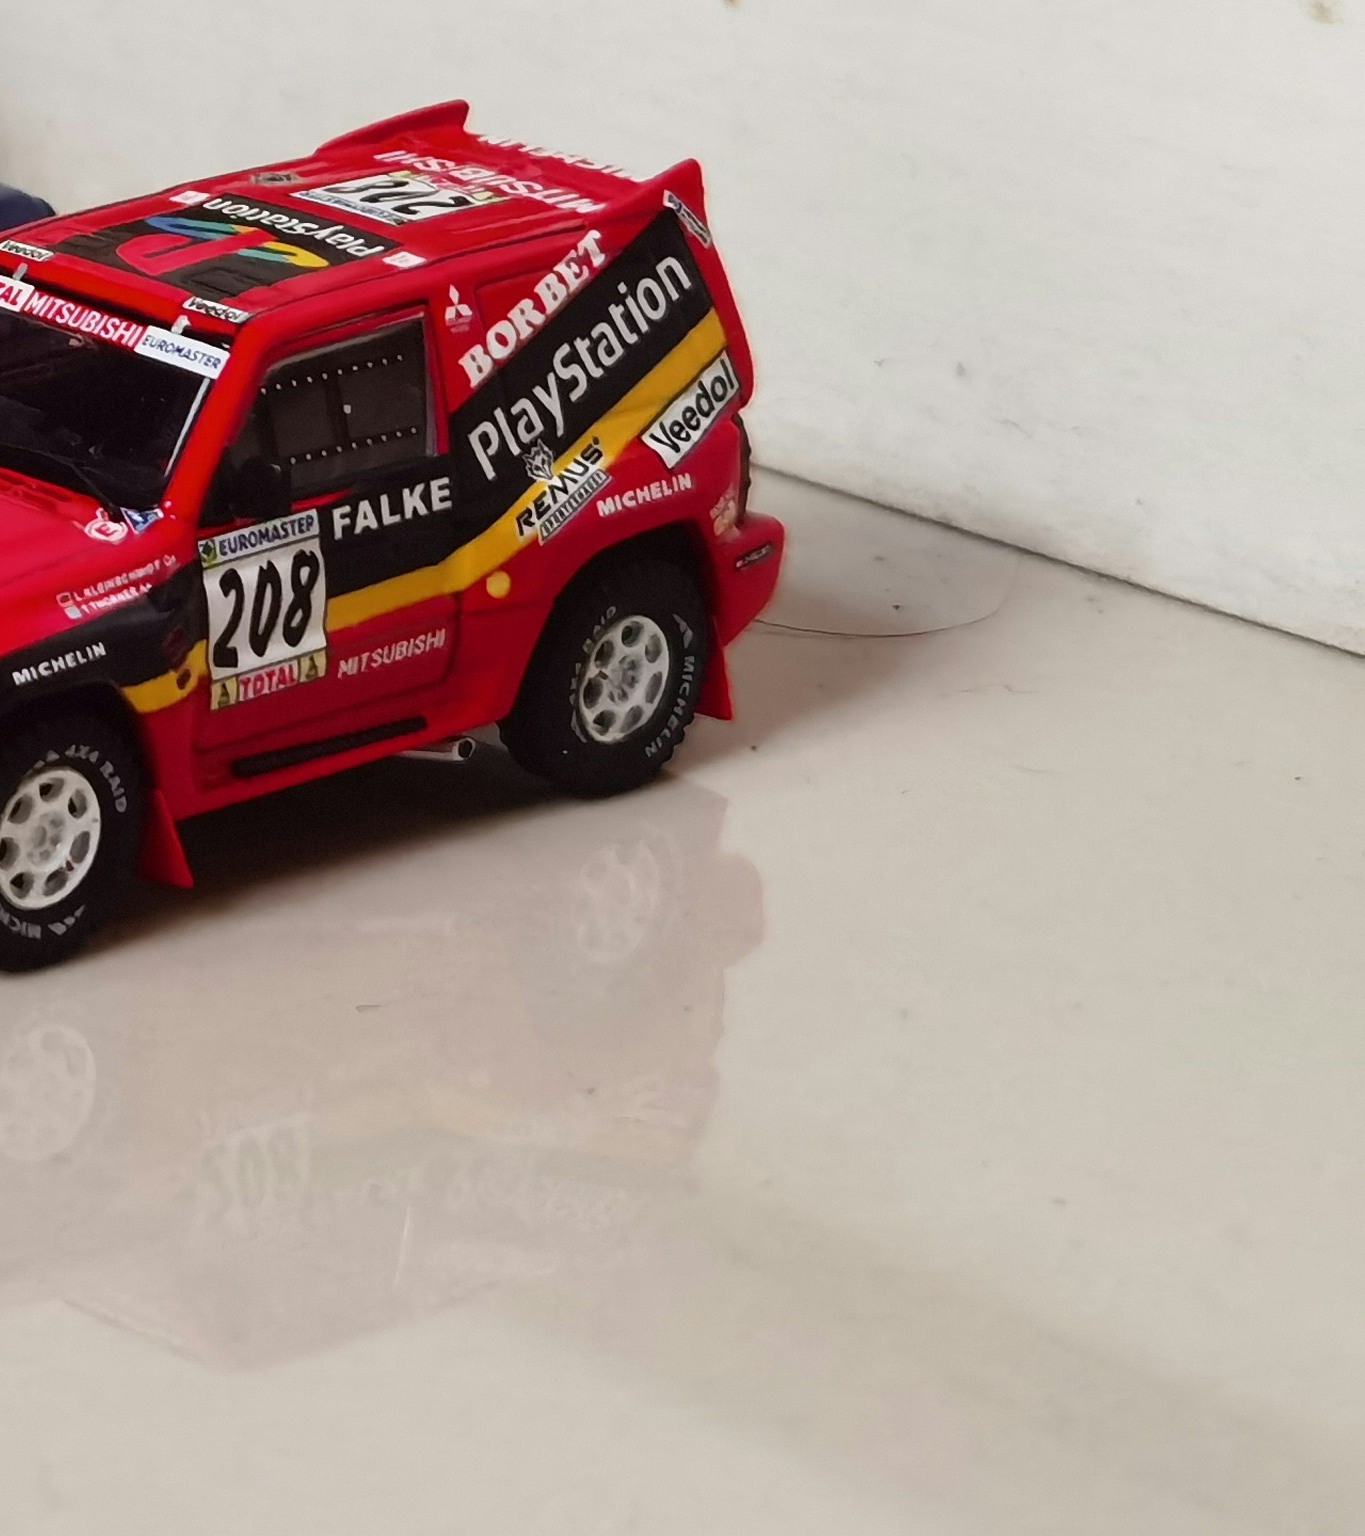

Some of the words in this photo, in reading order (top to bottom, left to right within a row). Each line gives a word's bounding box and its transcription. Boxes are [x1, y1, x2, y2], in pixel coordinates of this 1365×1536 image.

[202, 198, 386, 258] PlayStation
[23, 291, 138, 347] MITSUBISHI
[141, 333, 222, 370] EUROMASTER
[458, 229, 607, 390] BORBET
[467, 255, 693, 482] PlayStation
[649, 358, 736, 455] Veedol
[331, 476, 453, 541] FALKE
[515, 439, 604, 537] REMUS
[595, 472, 692, 518] MICHELIN
[212, 548, 320, 668] 208
[11, 641, 107, 686] MICHELIN
[239, 662, 298, 701] TOTAL
[337, 628, 447, 680] MITSUBISHI
[644, 655, 696, 758] MICHELIN
